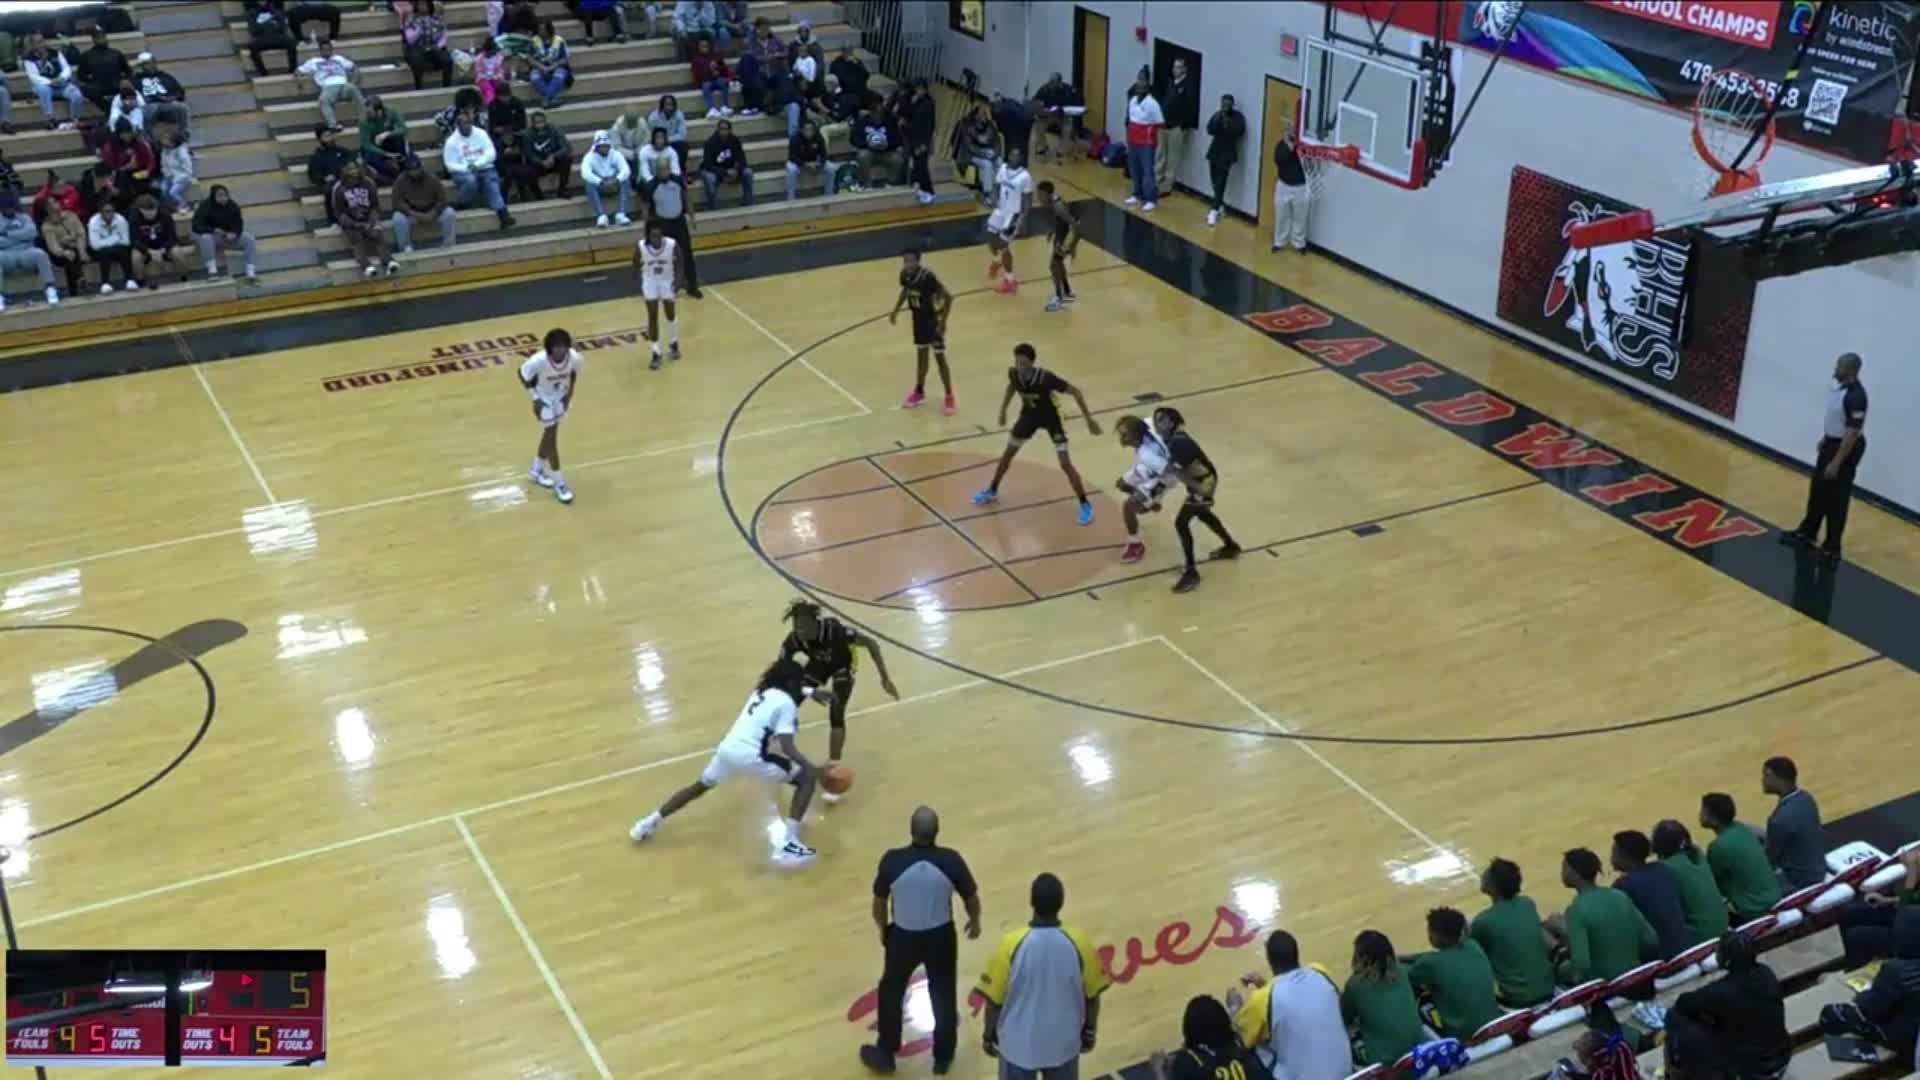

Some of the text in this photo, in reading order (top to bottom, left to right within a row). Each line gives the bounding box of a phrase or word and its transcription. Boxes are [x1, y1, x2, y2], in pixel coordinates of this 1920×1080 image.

[1612, 1, 1769, 41] HOOL CHAMPS
[1829, 5, 1898, 41] kinetic
[1680, 59, 1800, 108] 478-453-358
[432, 332, 539, 359] COURT
[322, 354, 505, 393] LUNSFORD
[1243, 304, 1767, 548] BALDWIN
